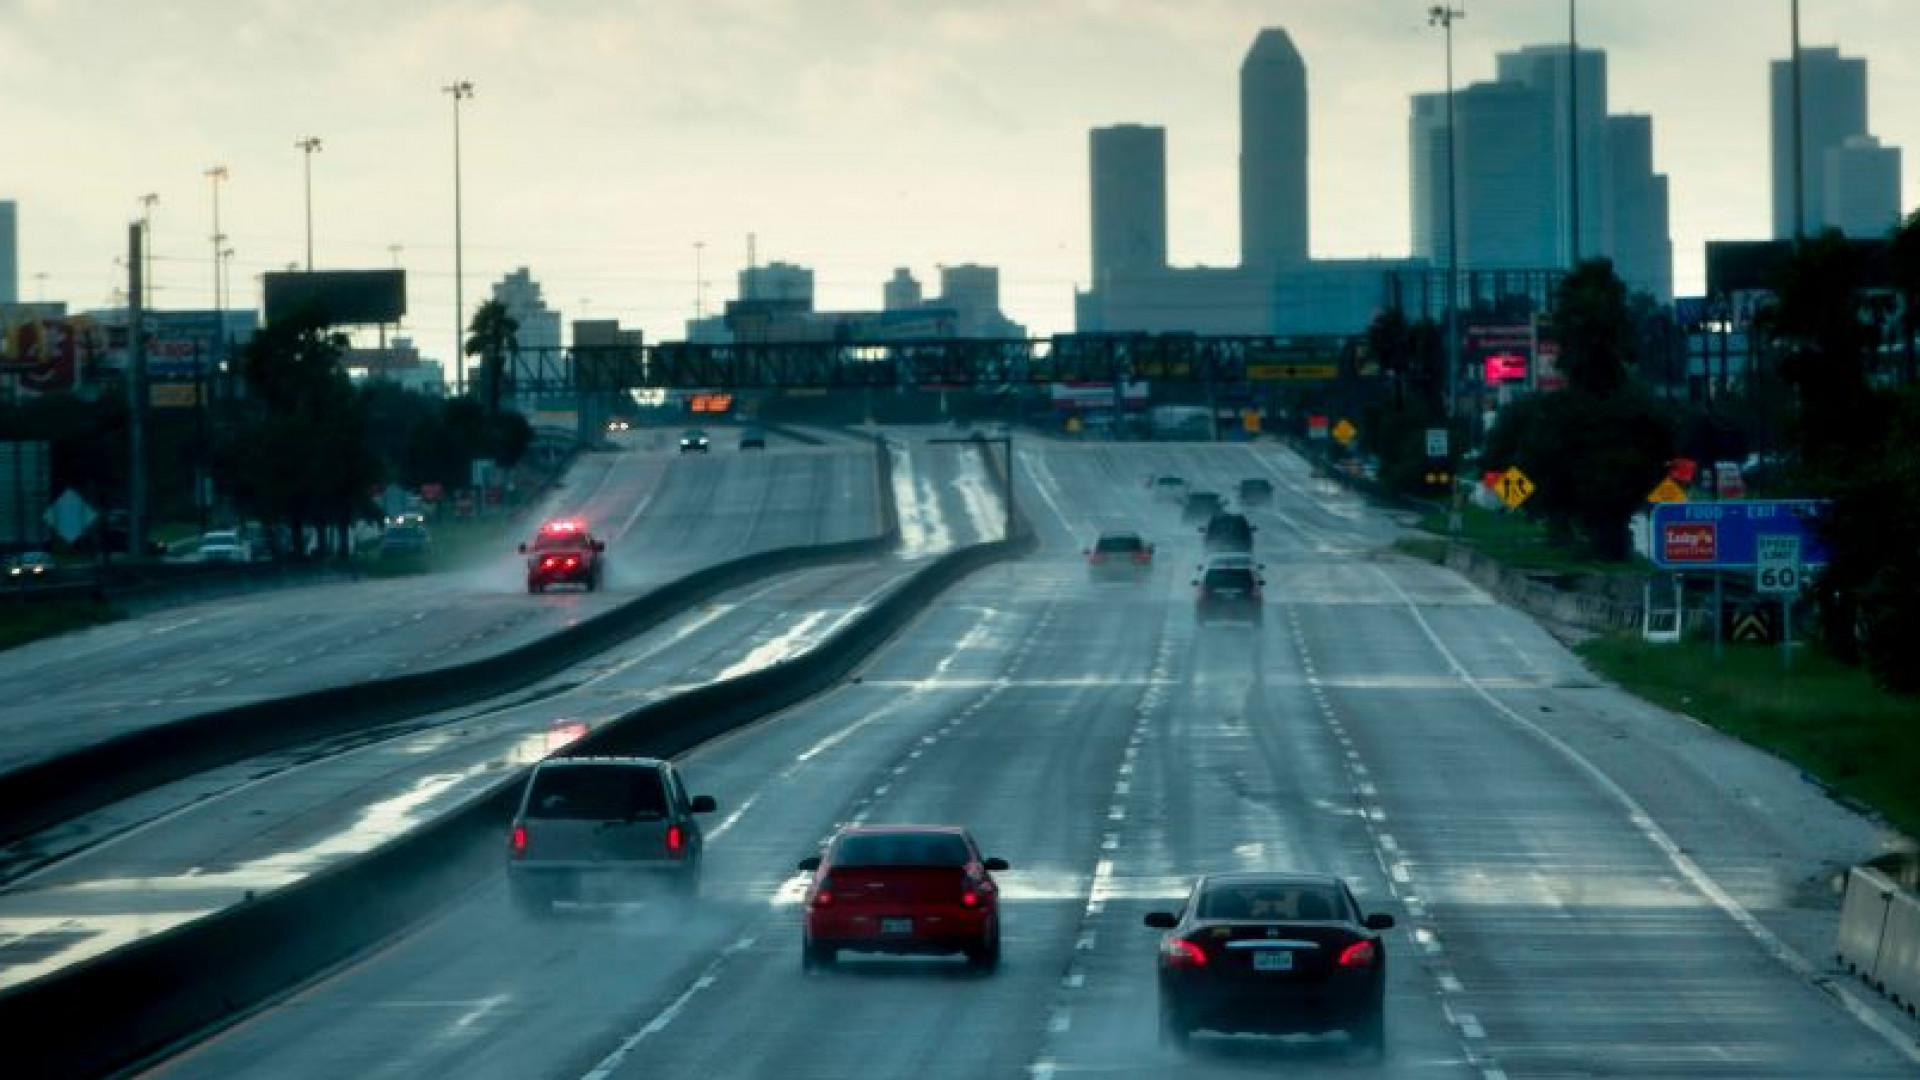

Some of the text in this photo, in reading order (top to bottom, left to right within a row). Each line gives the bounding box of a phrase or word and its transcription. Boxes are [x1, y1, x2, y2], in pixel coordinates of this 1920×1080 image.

[1760, 539, 1798, 549] SPEED
[1763, 551, 1792, 559] LIMIT
[1762, 568, 1795, 586] 60
